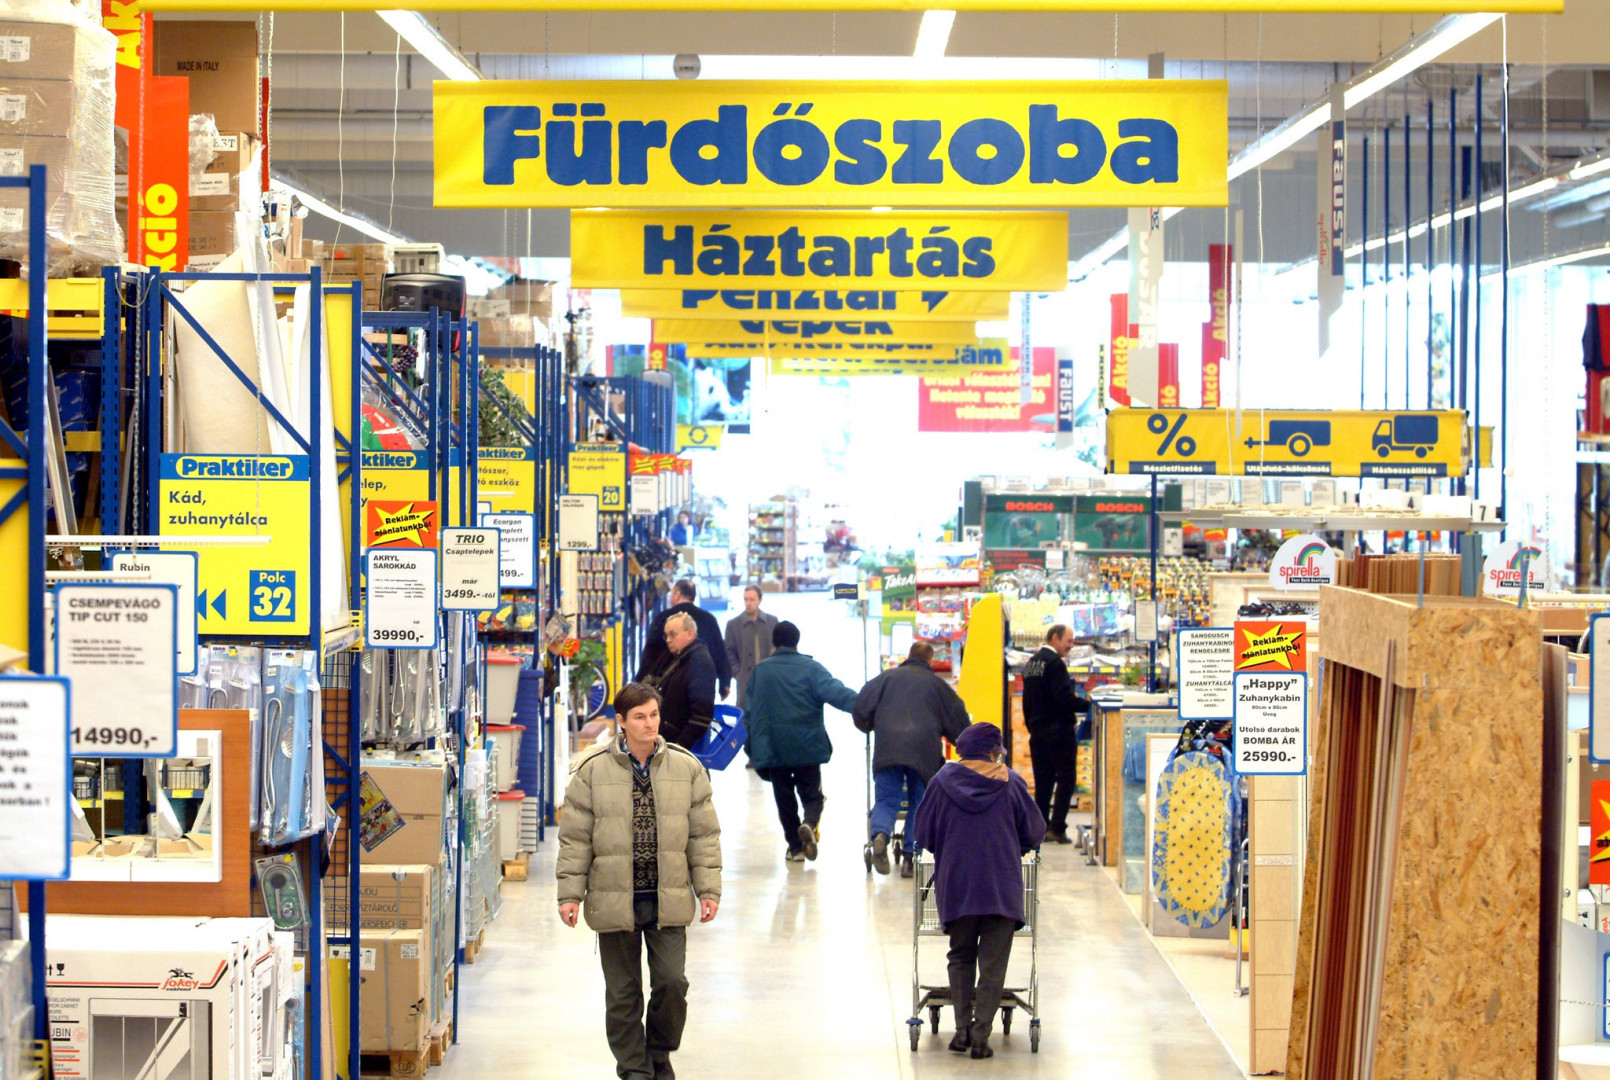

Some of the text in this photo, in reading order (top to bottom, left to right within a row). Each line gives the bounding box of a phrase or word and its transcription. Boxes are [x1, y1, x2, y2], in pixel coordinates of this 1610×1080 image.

[177, 61, 219, 71] MADE IN ITALY
[483, 103, 1179, 186] Fürdőszoba
[643, 223, 996, 279] Háztartás
[1212, 288, 1227, 341] Akció
[1112, 336, 1129, 389] Akció
[577, 443, 618, 452] Praktiker
[182, 458, 290, 477] Praktiker
[489, 477, 520, 486] eszköz
[169, 490, 206, 506] Kád,
[603, 492, 618, 504] 20
[1005, 502, 1055, 511] BOSCH
[1096, 503, 1145, 512] BOSCH
[1479, 505, 1487, 521] 7
[169, 511, 268, 529] zuhanytálca
[385, 513, 420, 526] Reklám-
[493, 518, 522, 526] Ecorgan
[375, 521, 432, 537] ajánlatunkból
[455, 535, 485, 544] TRIO
[567, 541, 592, 549] 1299,-
[373, 554, 400, 562] AKRYL
[445, 548, 494, 556] Csaptelepek
[120, 563, 150, 572] Rubin
[373, 562, 416, 570] SAROKKÁD
[1279, 556, 1320, 585] spirella
[259, 571, 286, 583] Polc
[1490, 560, 1534, 588] spirea
[884, 574, 916, 590] TakeA
[444, 589, 480, 599] 3499.-
[69, 597, 161, 609] CSEMPEVÁGÓ
[253, 586, 292, 617] 32
[69, 612, 148, 622] TIP CUT 150
[373, 629, 425, 643] 39990,-
[1253, 636, 1288, 646] Reklám-
[1242, 643, 1300, 659] ajánlatunkból
[1243, 679, 1297, 691] „Happy”
[1239, 694, 1301, 704] Zuhanykabin
[72, 727, 157, 749] 14990,-
[1243, 735, 1296, 745] BOMBA ÁR
[1242, 751, 1297, 762] 25990.-
[161, 978, 199, 990] jokey
